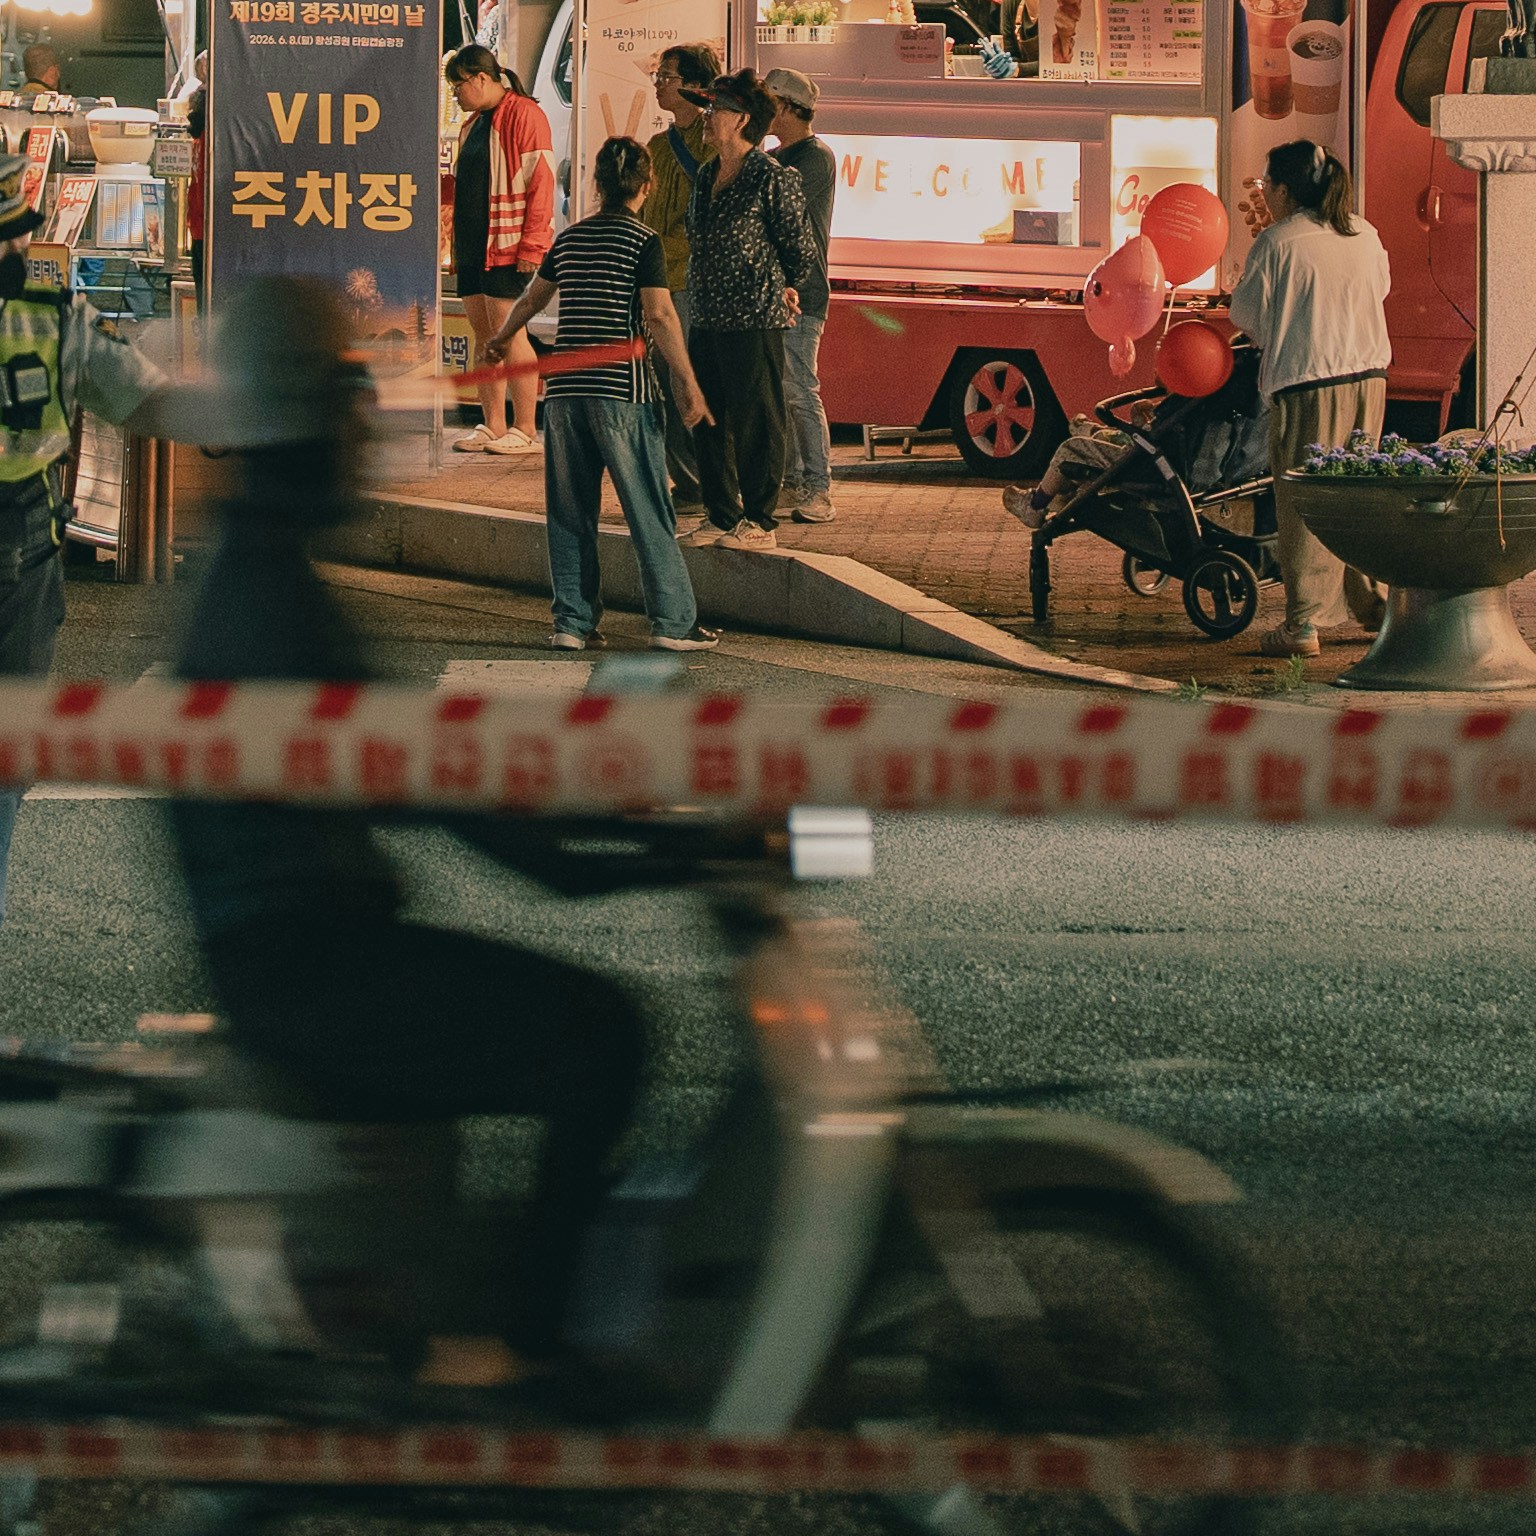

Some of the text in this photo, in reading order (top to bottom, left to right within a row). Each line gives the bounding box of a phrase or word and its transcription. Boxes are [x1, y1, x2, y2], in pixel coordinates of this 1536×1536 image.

[229, 0, 426, 27] 제19회 경주시민의 날
[617, 42, 635, 53] 6.0
[267, 92, 381, 146] VIP
[231, 170, 418, 232] 주차장
